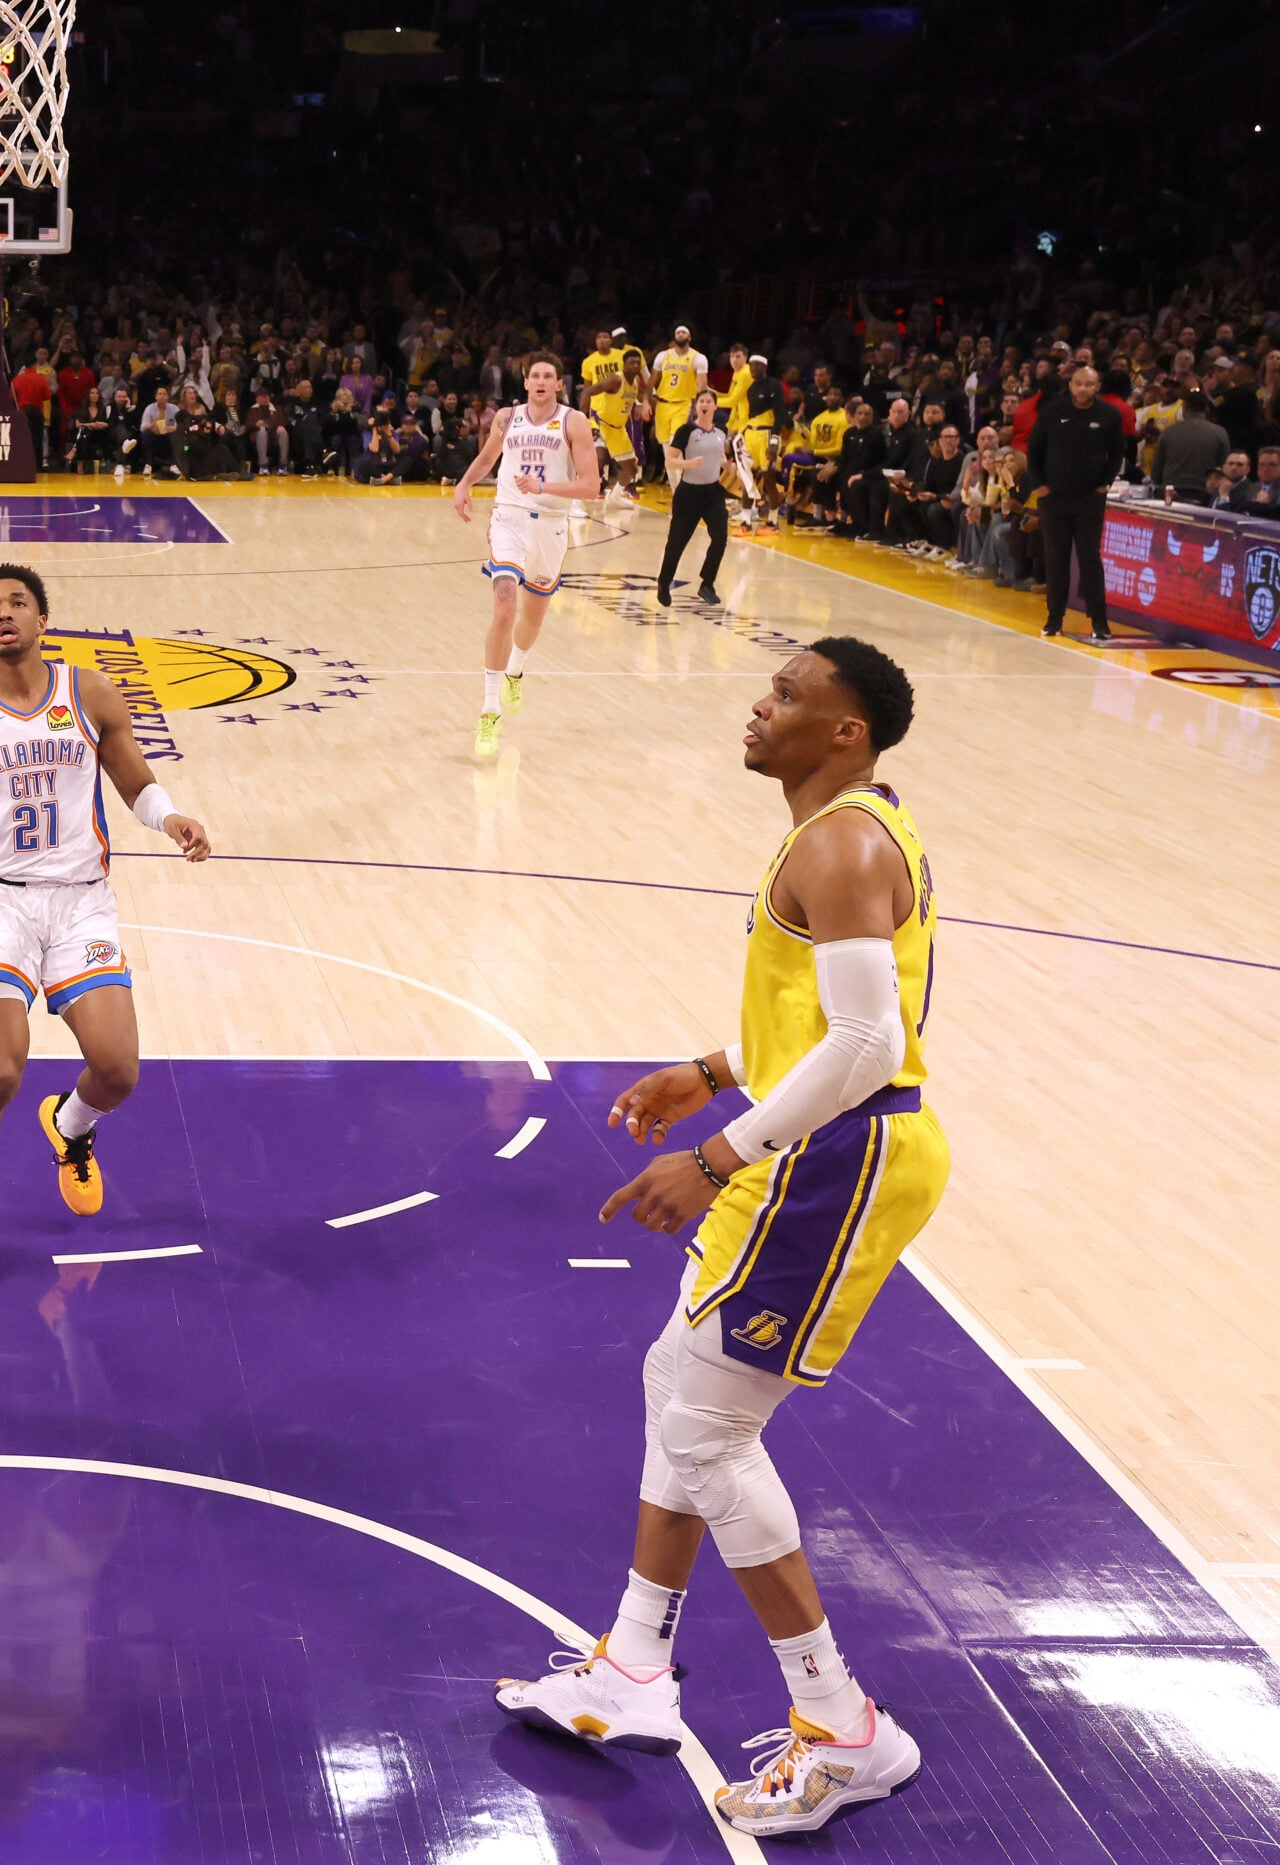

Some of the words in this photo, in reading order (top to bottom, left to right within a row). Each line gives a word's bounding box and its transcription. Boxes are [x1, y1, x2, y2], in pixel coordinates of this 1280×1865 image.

[669, 373, 680, 387] 3
[507, 434, 561, 451] OKLAHOMA
[522, 448, 545, 462] CITY
[8, 769, 58, 800] CITY
[12, 799, 61, 853] 21
